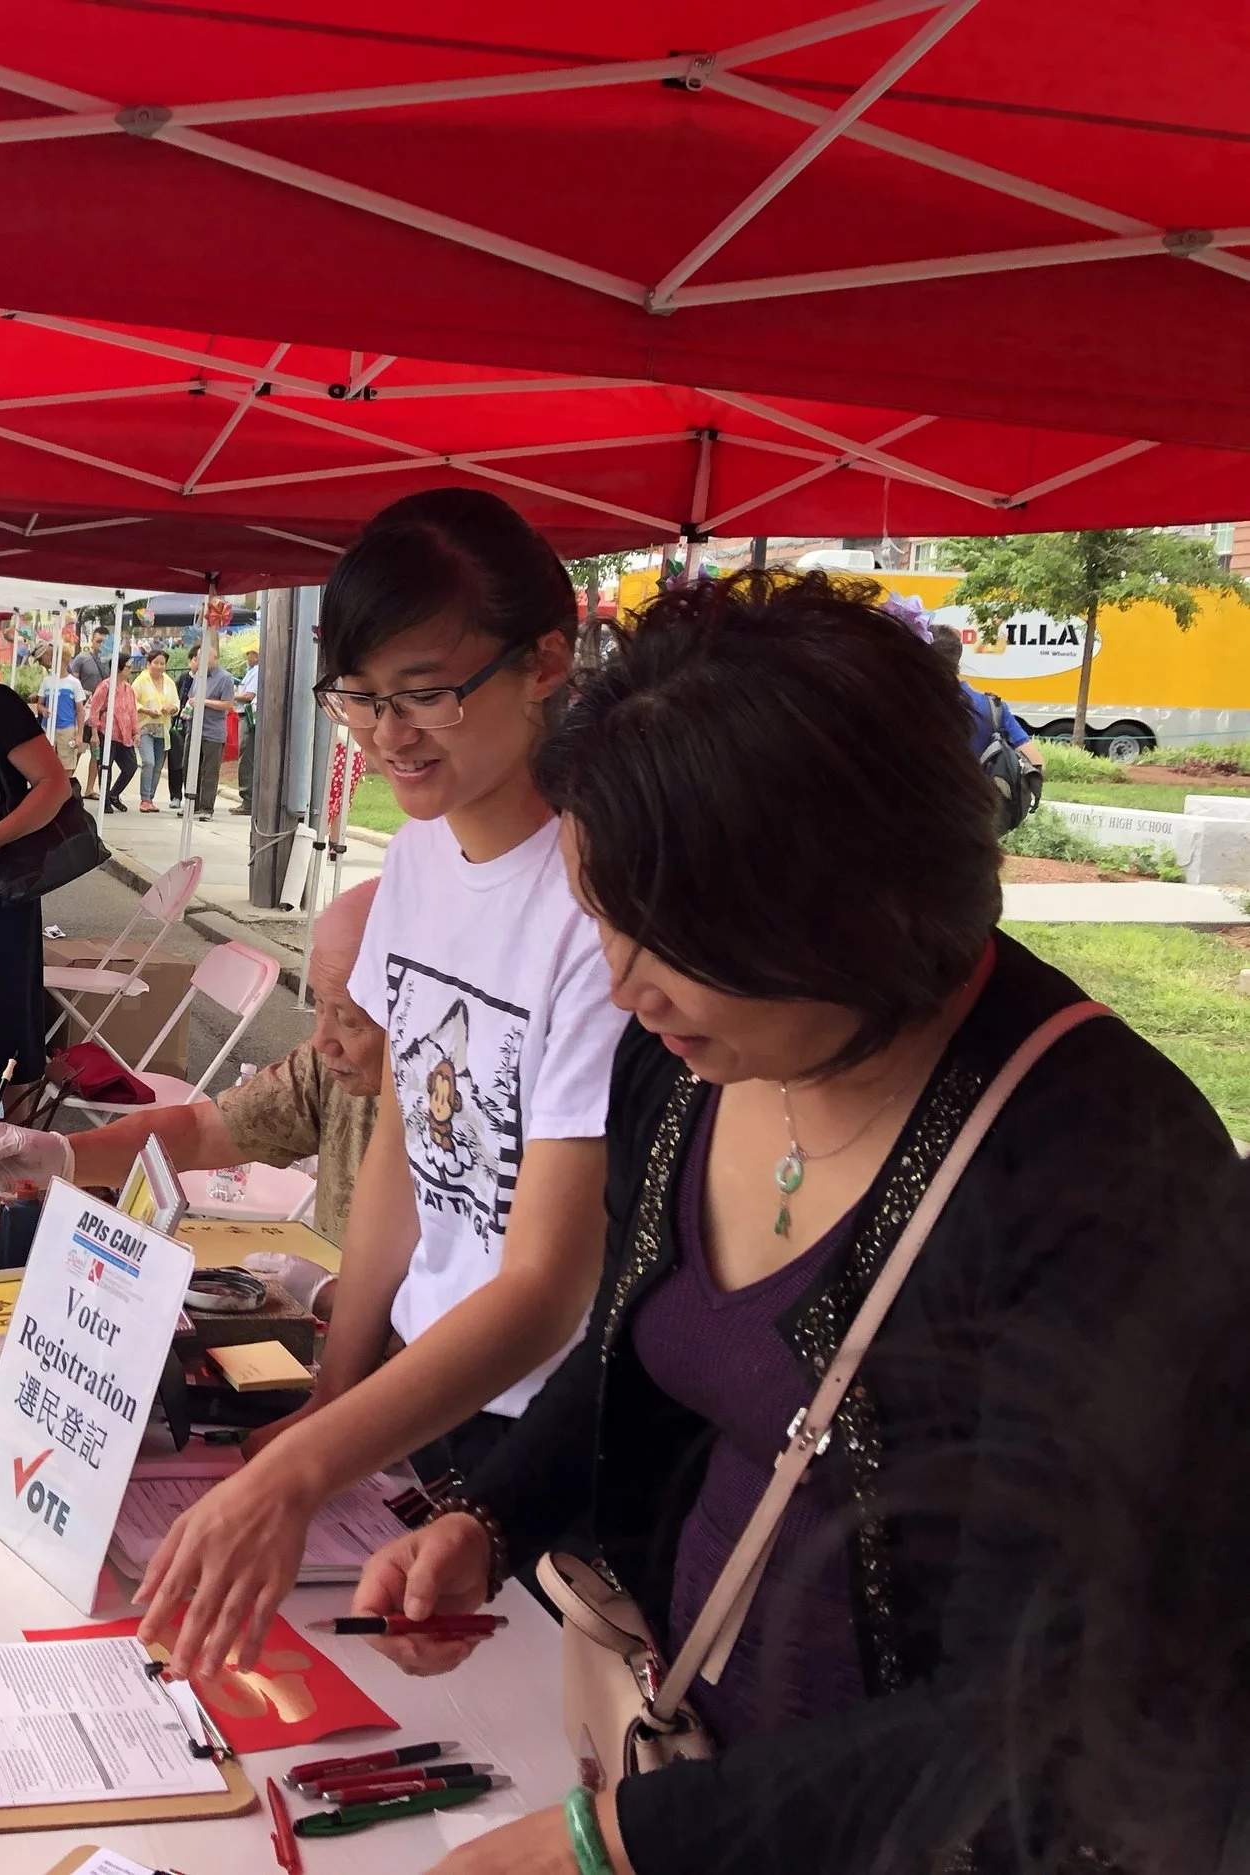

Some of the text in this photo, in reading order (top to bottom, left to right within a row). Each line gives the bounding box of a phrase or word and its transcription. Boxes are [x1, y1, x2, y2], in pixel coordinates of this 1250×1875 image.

[1109, 816, 1133, 830] HIGH
[1137, 820, 1173, 835] SCHOOL
[76, 1210, 110, 1242] APIs
[109, 1228, 148, 1263] CAN!
[66, 1285, 121, 1347] Voter
[17, 1314, 138, 1424] Registration
[14, 1371, 108, 1470] 選民登記
[13, 1448, 71, 1537] VOTE
